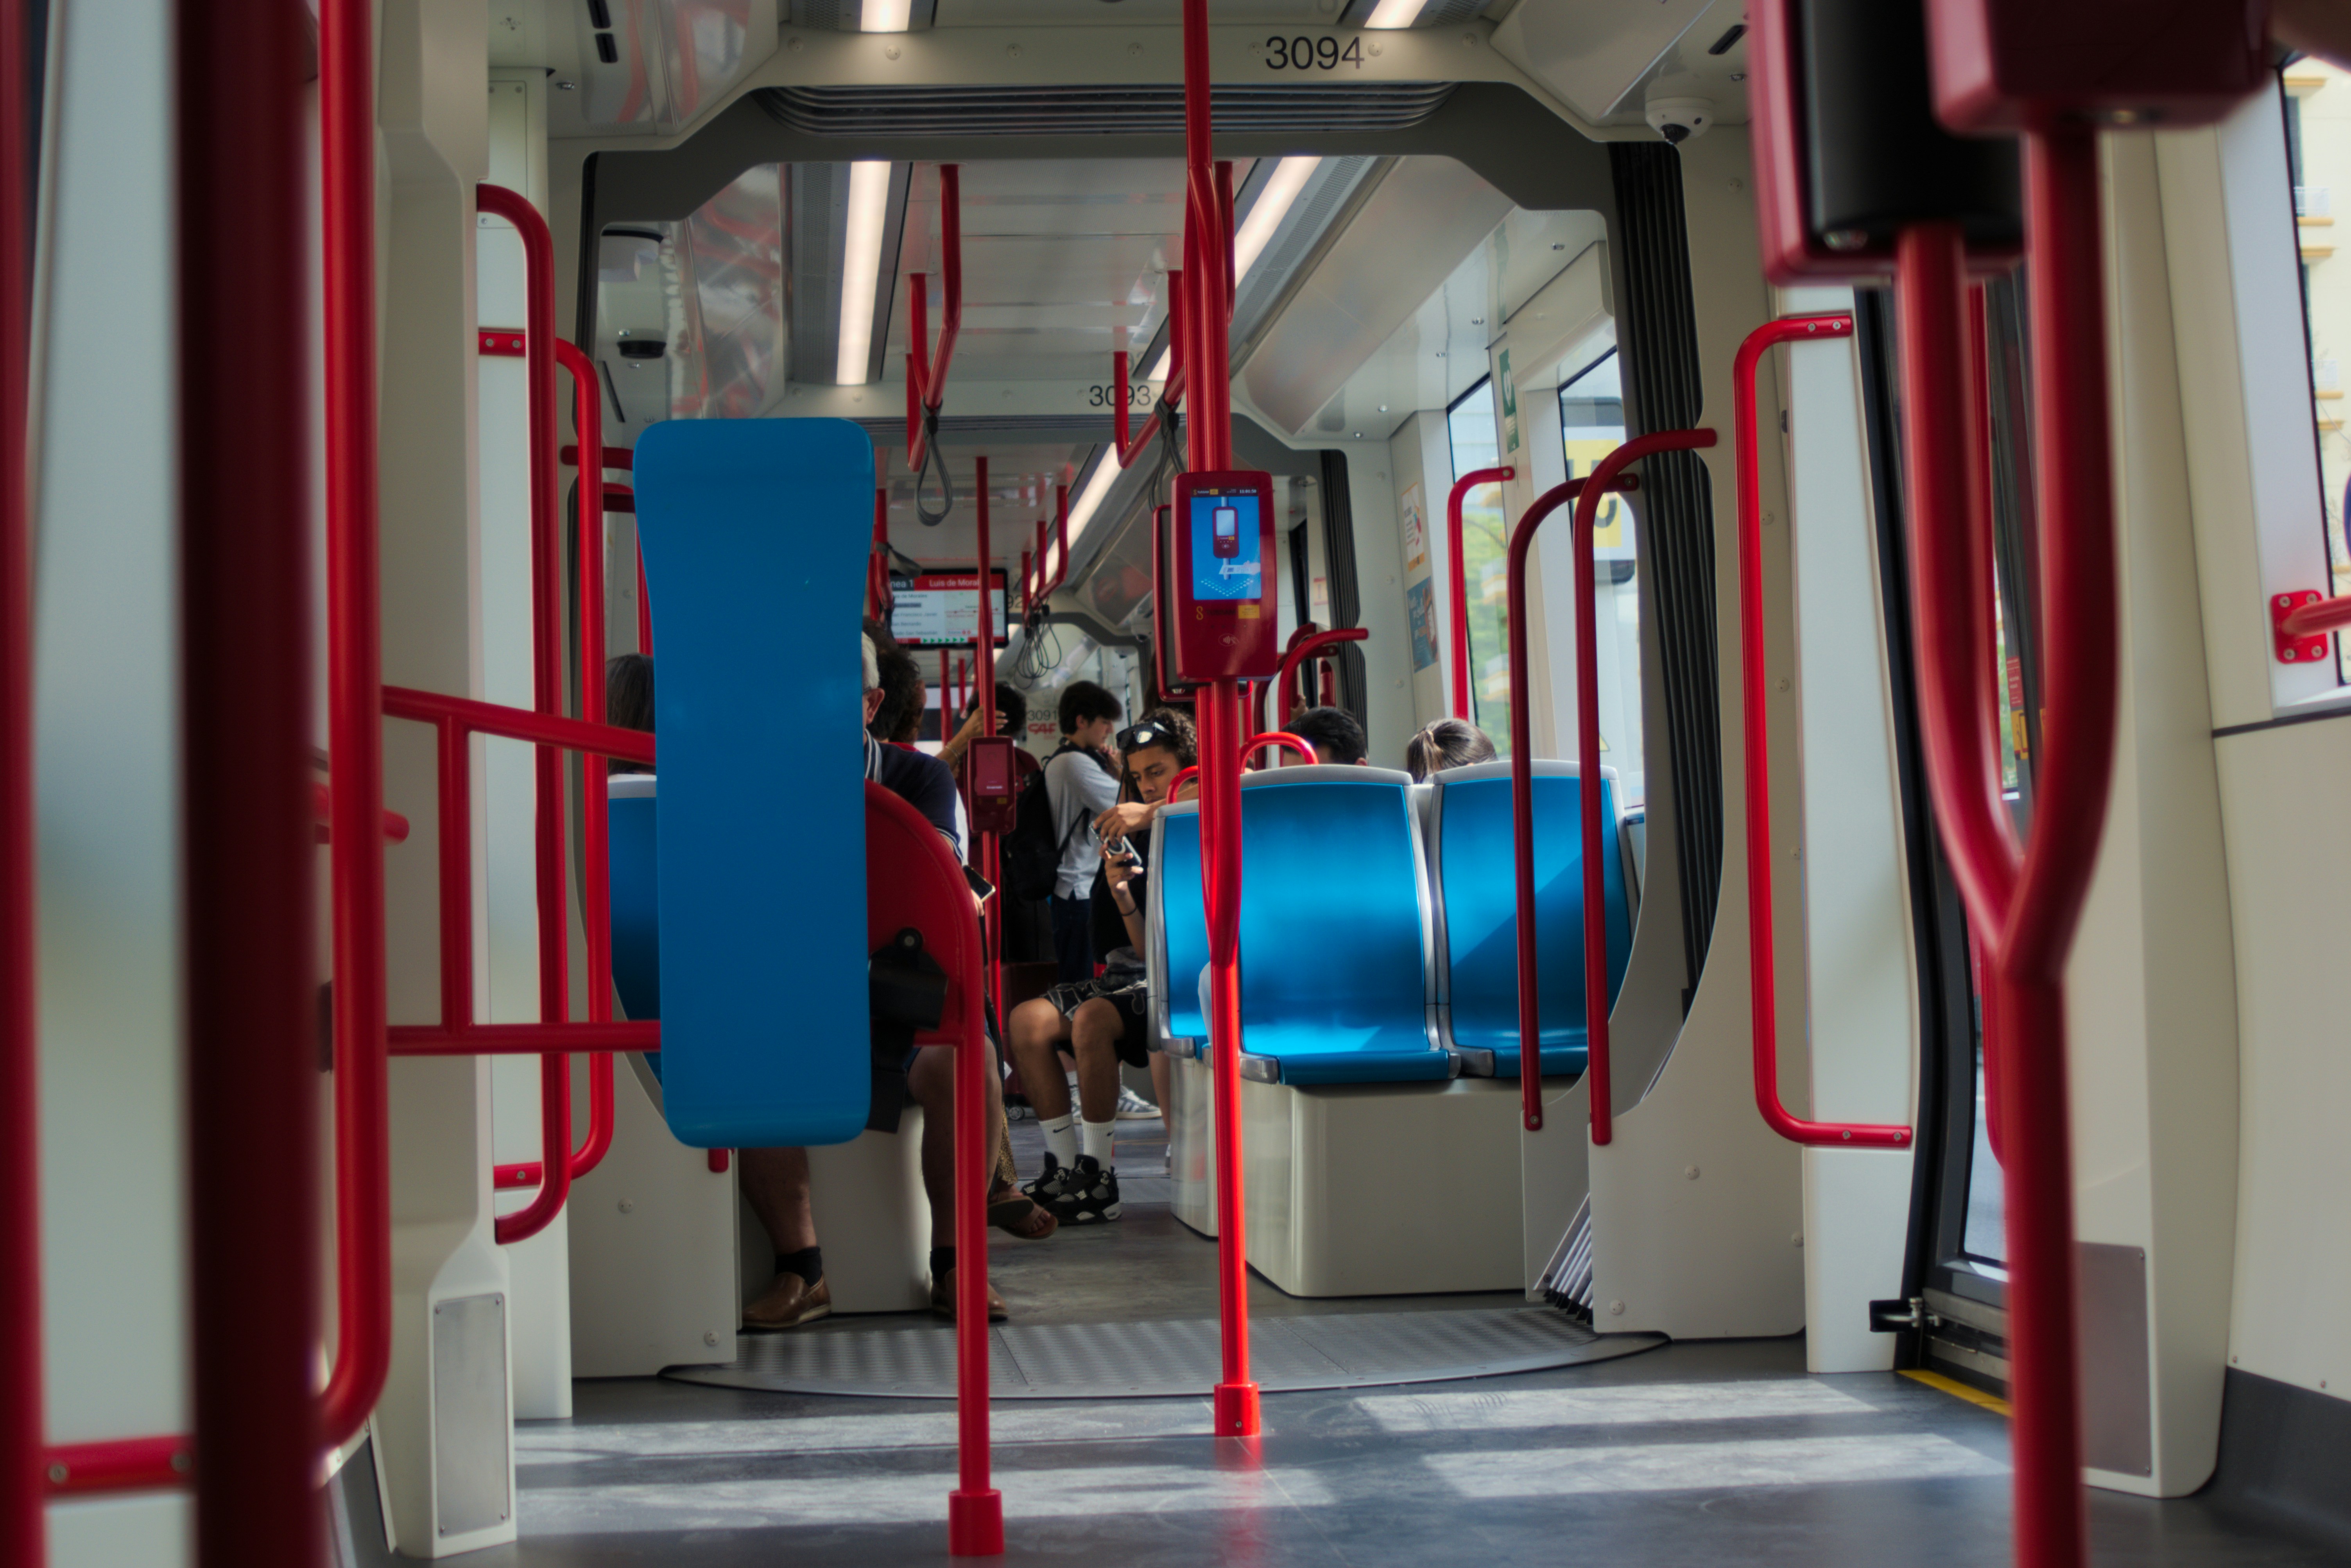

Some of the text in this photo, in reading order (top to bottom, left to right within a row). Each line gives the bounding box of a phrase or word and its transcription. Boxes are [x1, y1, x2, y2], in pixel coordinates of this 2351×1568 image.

[1265, 36, 1365, 70] 3094
[1089, 385, 1150, 406] 3093
[909, 579, 913, 587] 1
[929, 579, 945, 587] Luis
[958, 578, 979, 587] Moral
[1027, 710, 1057, 721] 3091
[1028, 723, 1057, 734] CAF
